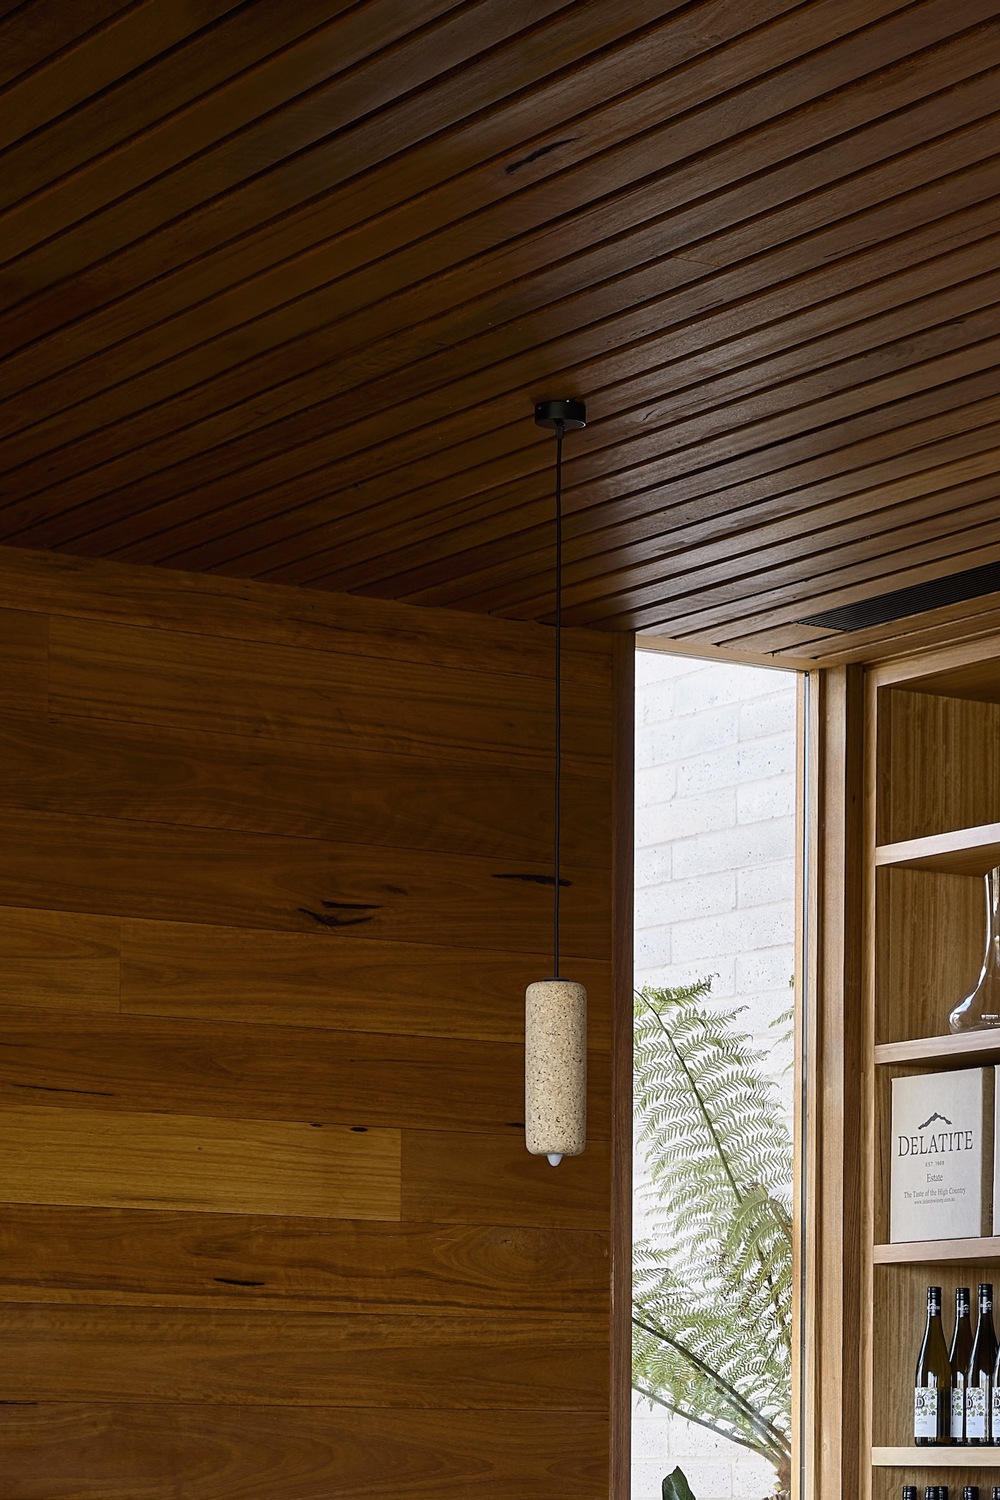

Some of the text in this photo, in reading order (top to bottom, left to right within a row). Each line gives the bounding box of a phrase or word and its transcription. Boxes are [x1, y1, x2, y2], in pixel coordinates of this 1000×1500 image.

[898, 1131, 973, 1156] DELATITE
[927, 1174, 943, 1182] Estate
[938, 1188, 948, 1196] High
[949, 1187, 966, 1195] Country
